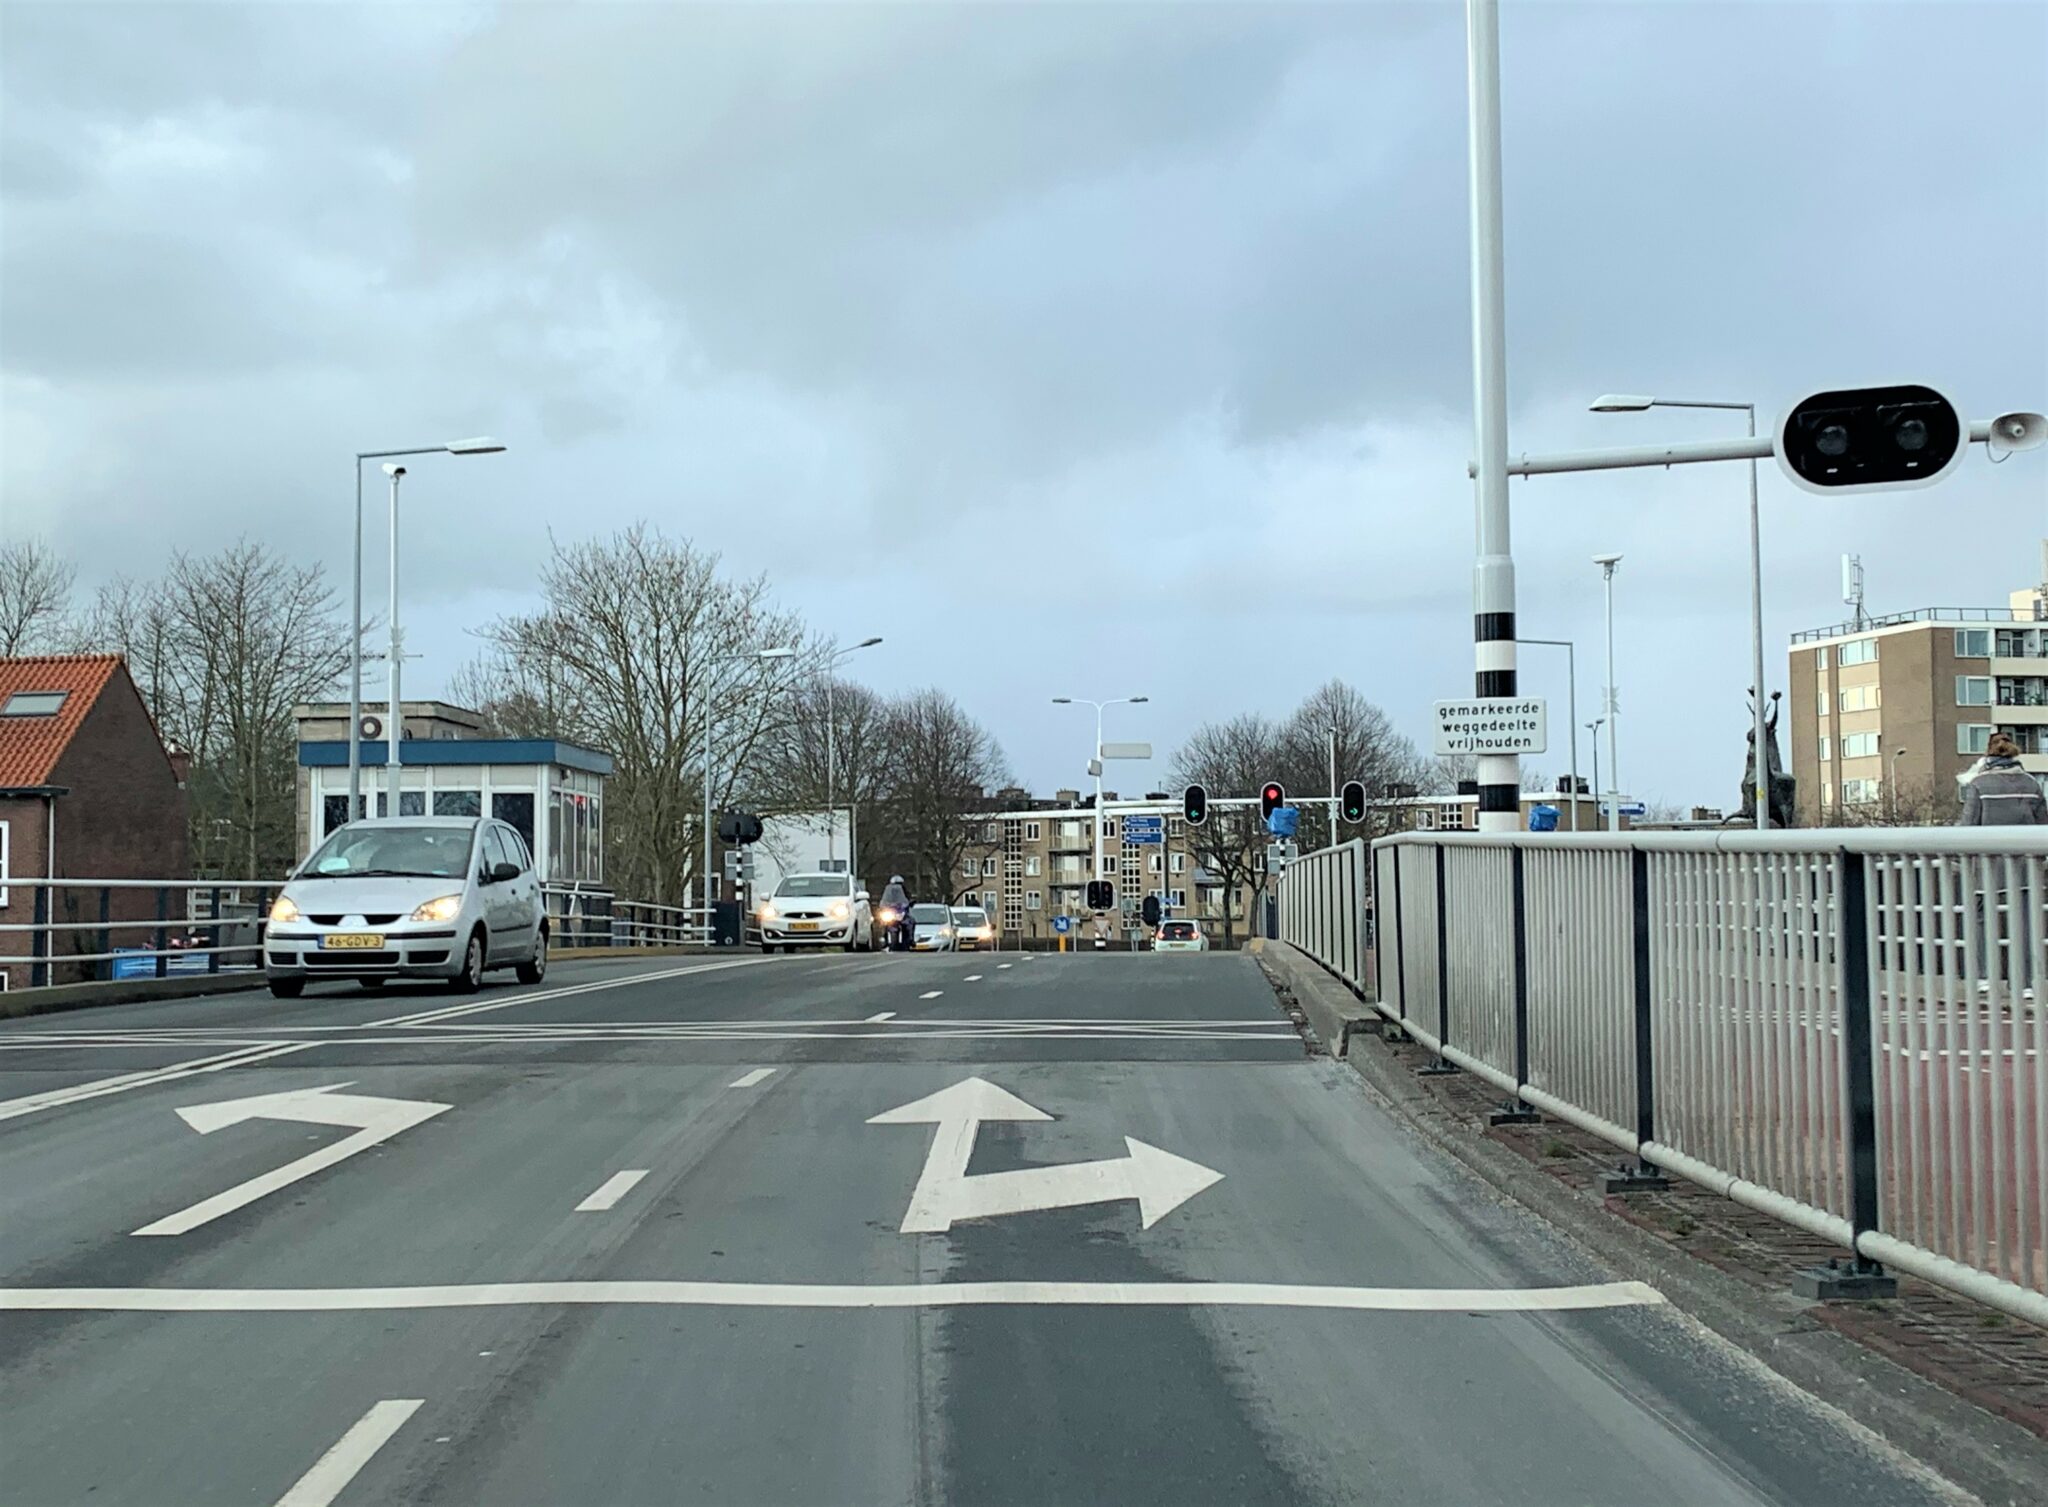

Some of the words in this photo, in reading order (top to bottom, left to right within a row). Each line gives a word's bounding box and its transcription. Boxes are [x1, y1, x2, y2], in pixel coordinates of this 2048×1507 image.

[1439, 702, 1539, 720] gemarkeerde
[1442, 719, 1537, 735] weggedeelte
[1447, 736, 1532, 752] vrijhouden
